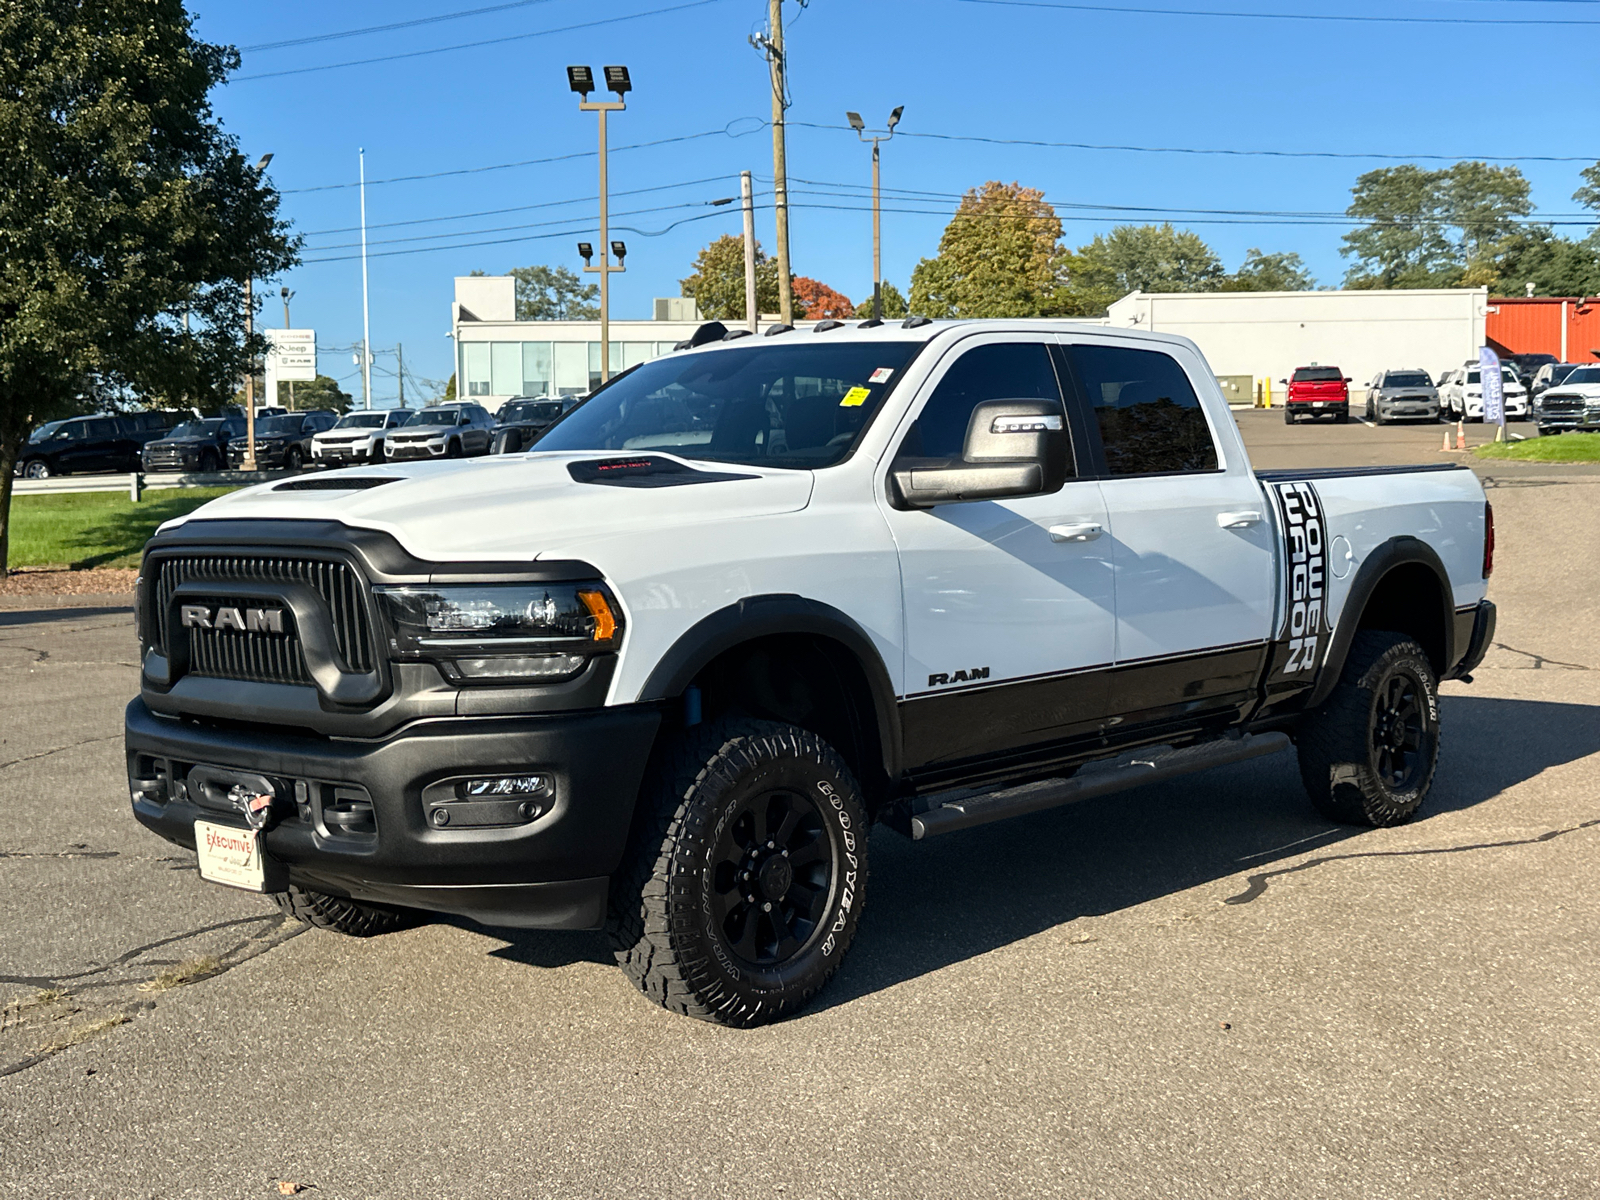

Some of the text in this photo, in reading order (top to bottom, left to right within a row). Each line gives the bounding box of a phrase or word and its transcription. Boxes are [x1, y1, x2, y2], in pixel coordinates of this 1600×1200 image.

[286, 345, 307, 353] Jeep
[181, 605, 284, 633] RAM
[1280, 483, 1307, 674] WAGON
[1293, 482, 1323, 671] POWER
[928, 667, 990, 687] RAM
[206, 830, 252, 854] EXECUTIVE
[702, 800, 740, 981] WRANGLER
[817, 780, 858, 956] GOODYEAR
